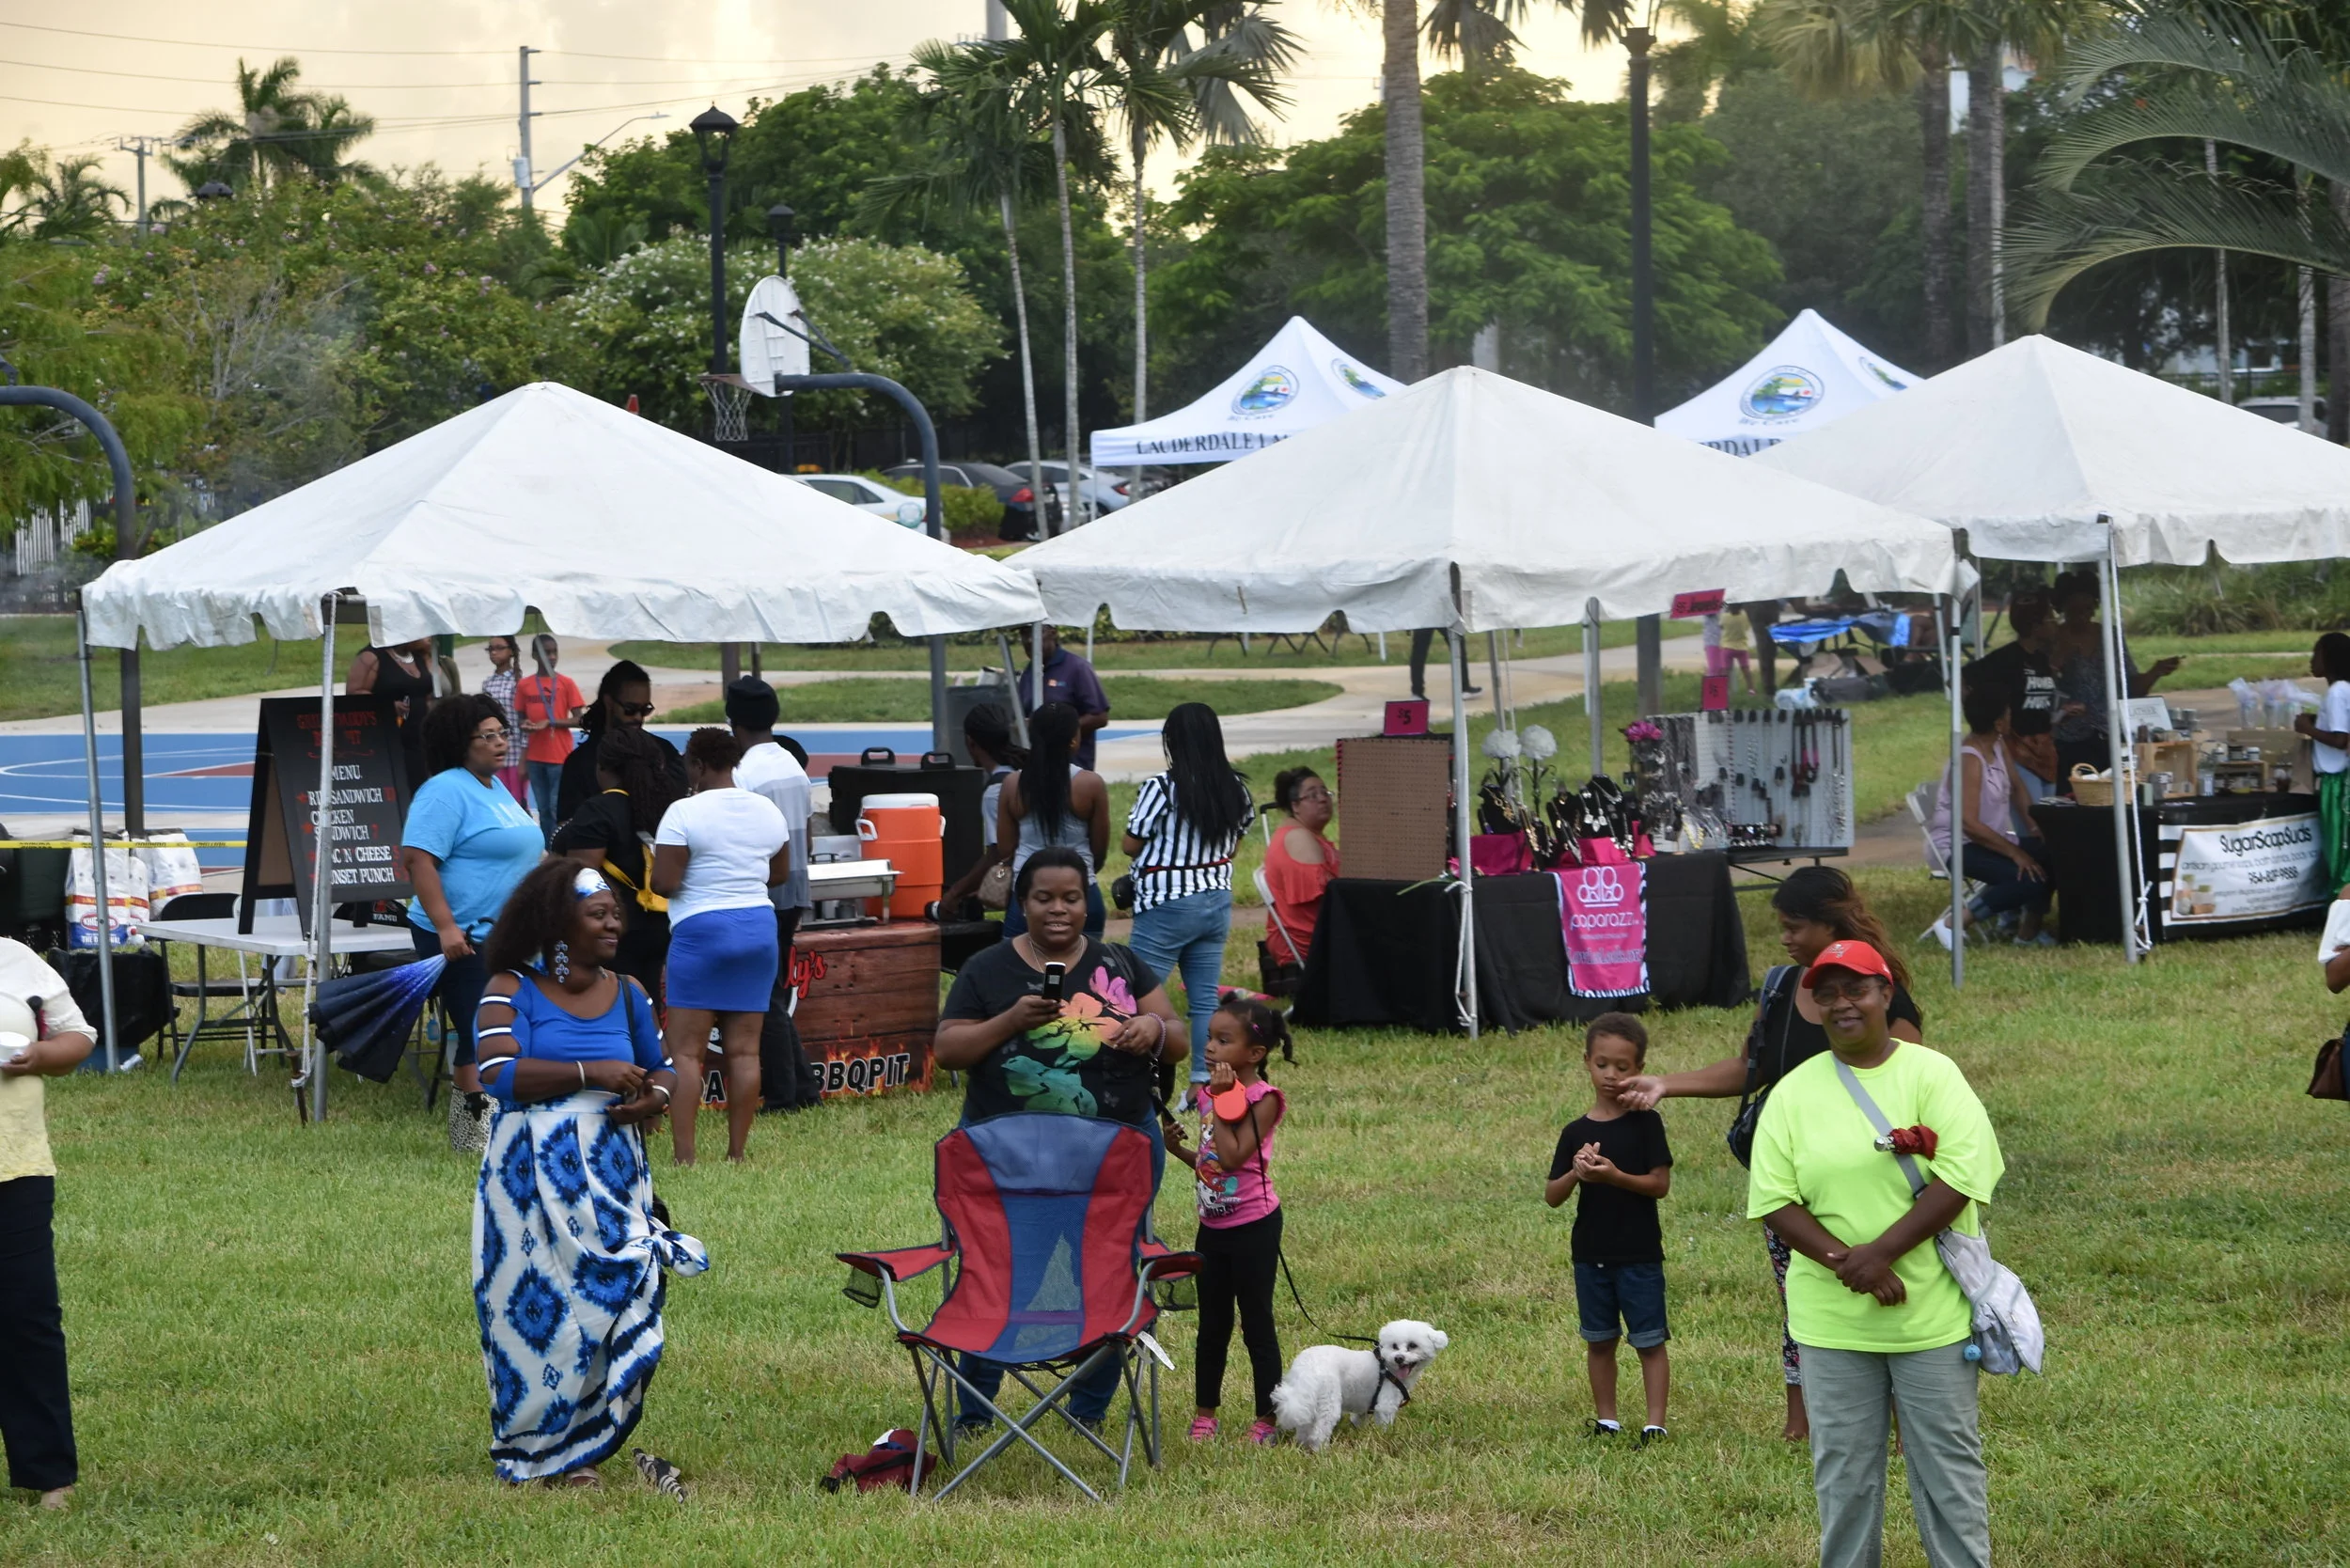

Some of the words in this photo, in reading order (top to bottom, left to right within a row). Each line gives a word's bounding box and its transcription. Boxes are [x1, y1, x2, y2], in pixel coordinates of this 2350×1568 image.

[1136, 432, 1254, 455] LAUDERDALE
[331, 788, 383, 806] SANDWICH
[354, 846, 392, 862] CHEESE
[360, 868, 396, 884] PUNCH
[373, 913, 398, 922] FAMU
